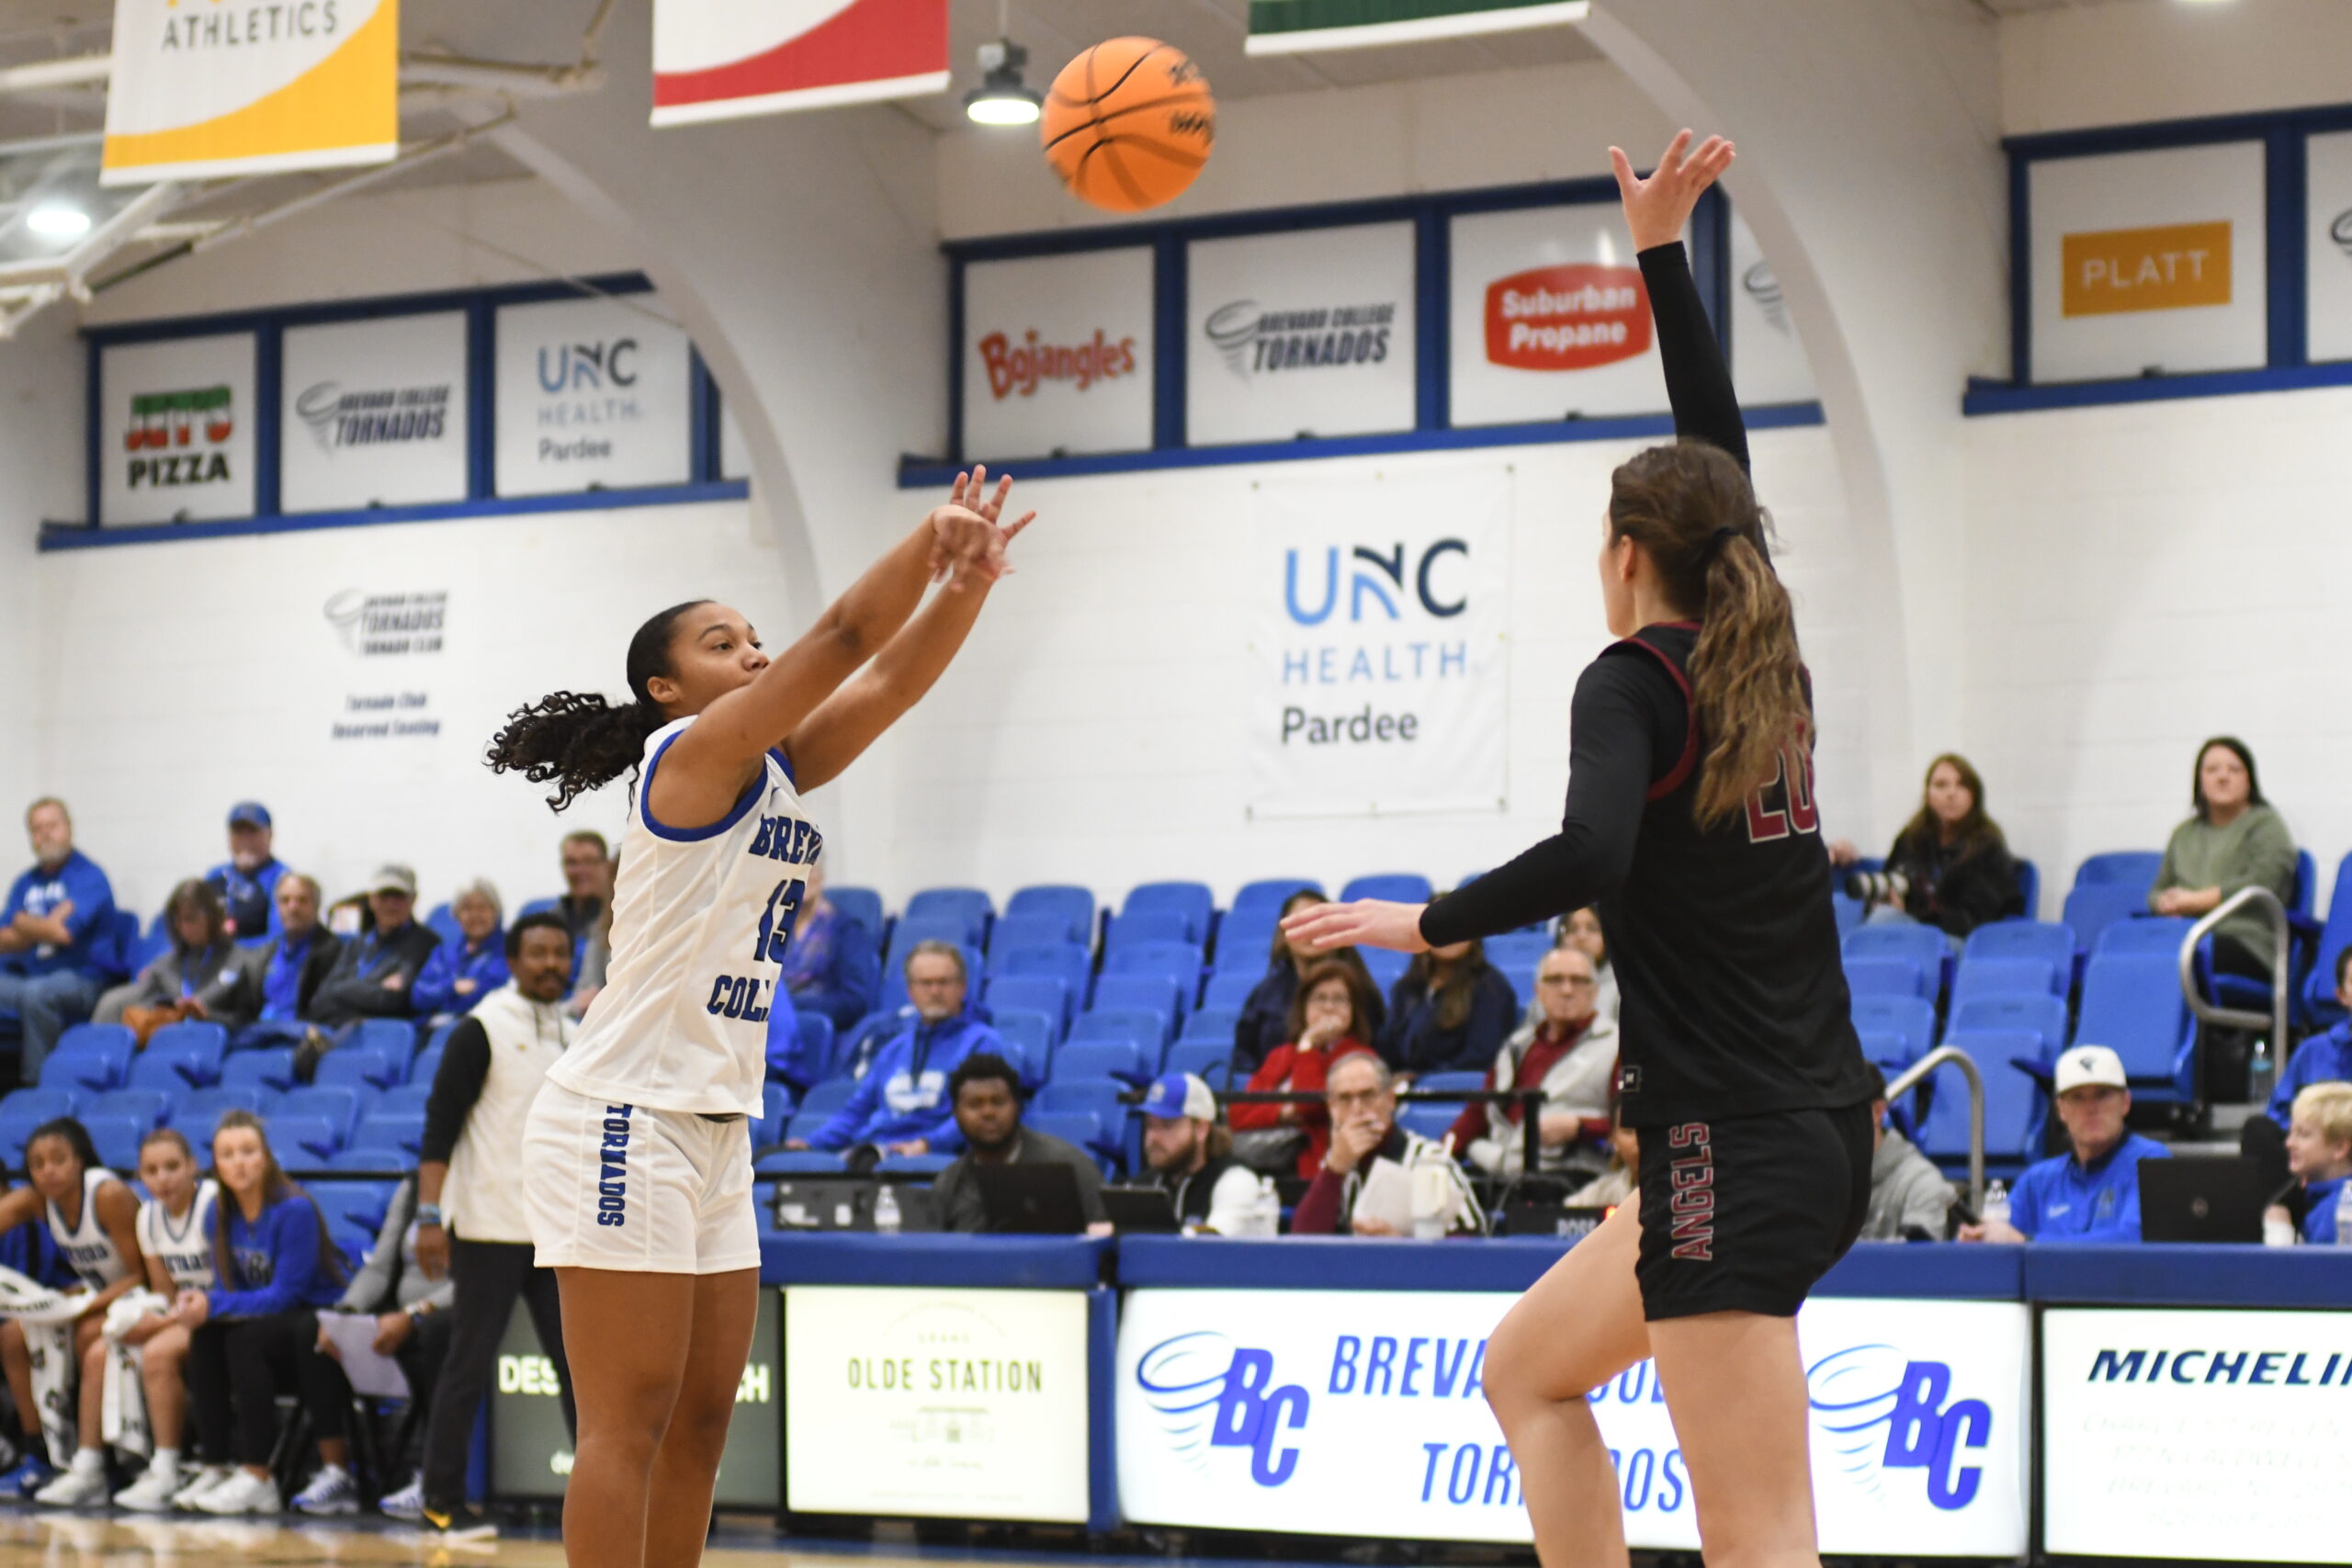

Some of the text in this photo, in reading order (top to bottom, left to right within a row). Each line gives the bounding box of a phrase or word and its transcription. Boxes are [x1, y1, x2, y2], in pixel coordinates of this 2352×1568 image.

[162, 1, 338, 50] ATHLETICS
[2081, 249, 2210, 290] PLATT
[1501, 285, 1638, 319] Suburban
[1253, 327, 1390, 372] TORNADOS
[1509, 322, 1628, 354] Propane
[537, 337, 640, 395] UNC
[978, 328, 1136, 400] Bojangles
[335, 407, 446, 447] TORNADOS
[128, 453, 230, 489] PIZZA
[1284, 537, 1468, 626] UNC
[1283, 642, 1468, 683] HEALTH
[1282, 704, 1419, 746] Pardee
[753, 878, 806, 964] 13
[707, 975, 771, 1022] COL
[597, 1103, 633, 1227] TORNADOS
[1669, 1122, 1714, 1261] ANGELS
[498, 1354, 561, 1396] DES
[848, 1357, 1043, 1393] OLDE STATION
[1329, 1335, 1487, 1398] BREVA
[1210, 1348, 1310, 1487] BC
[1883, 1360, 1993, 1511] BC
